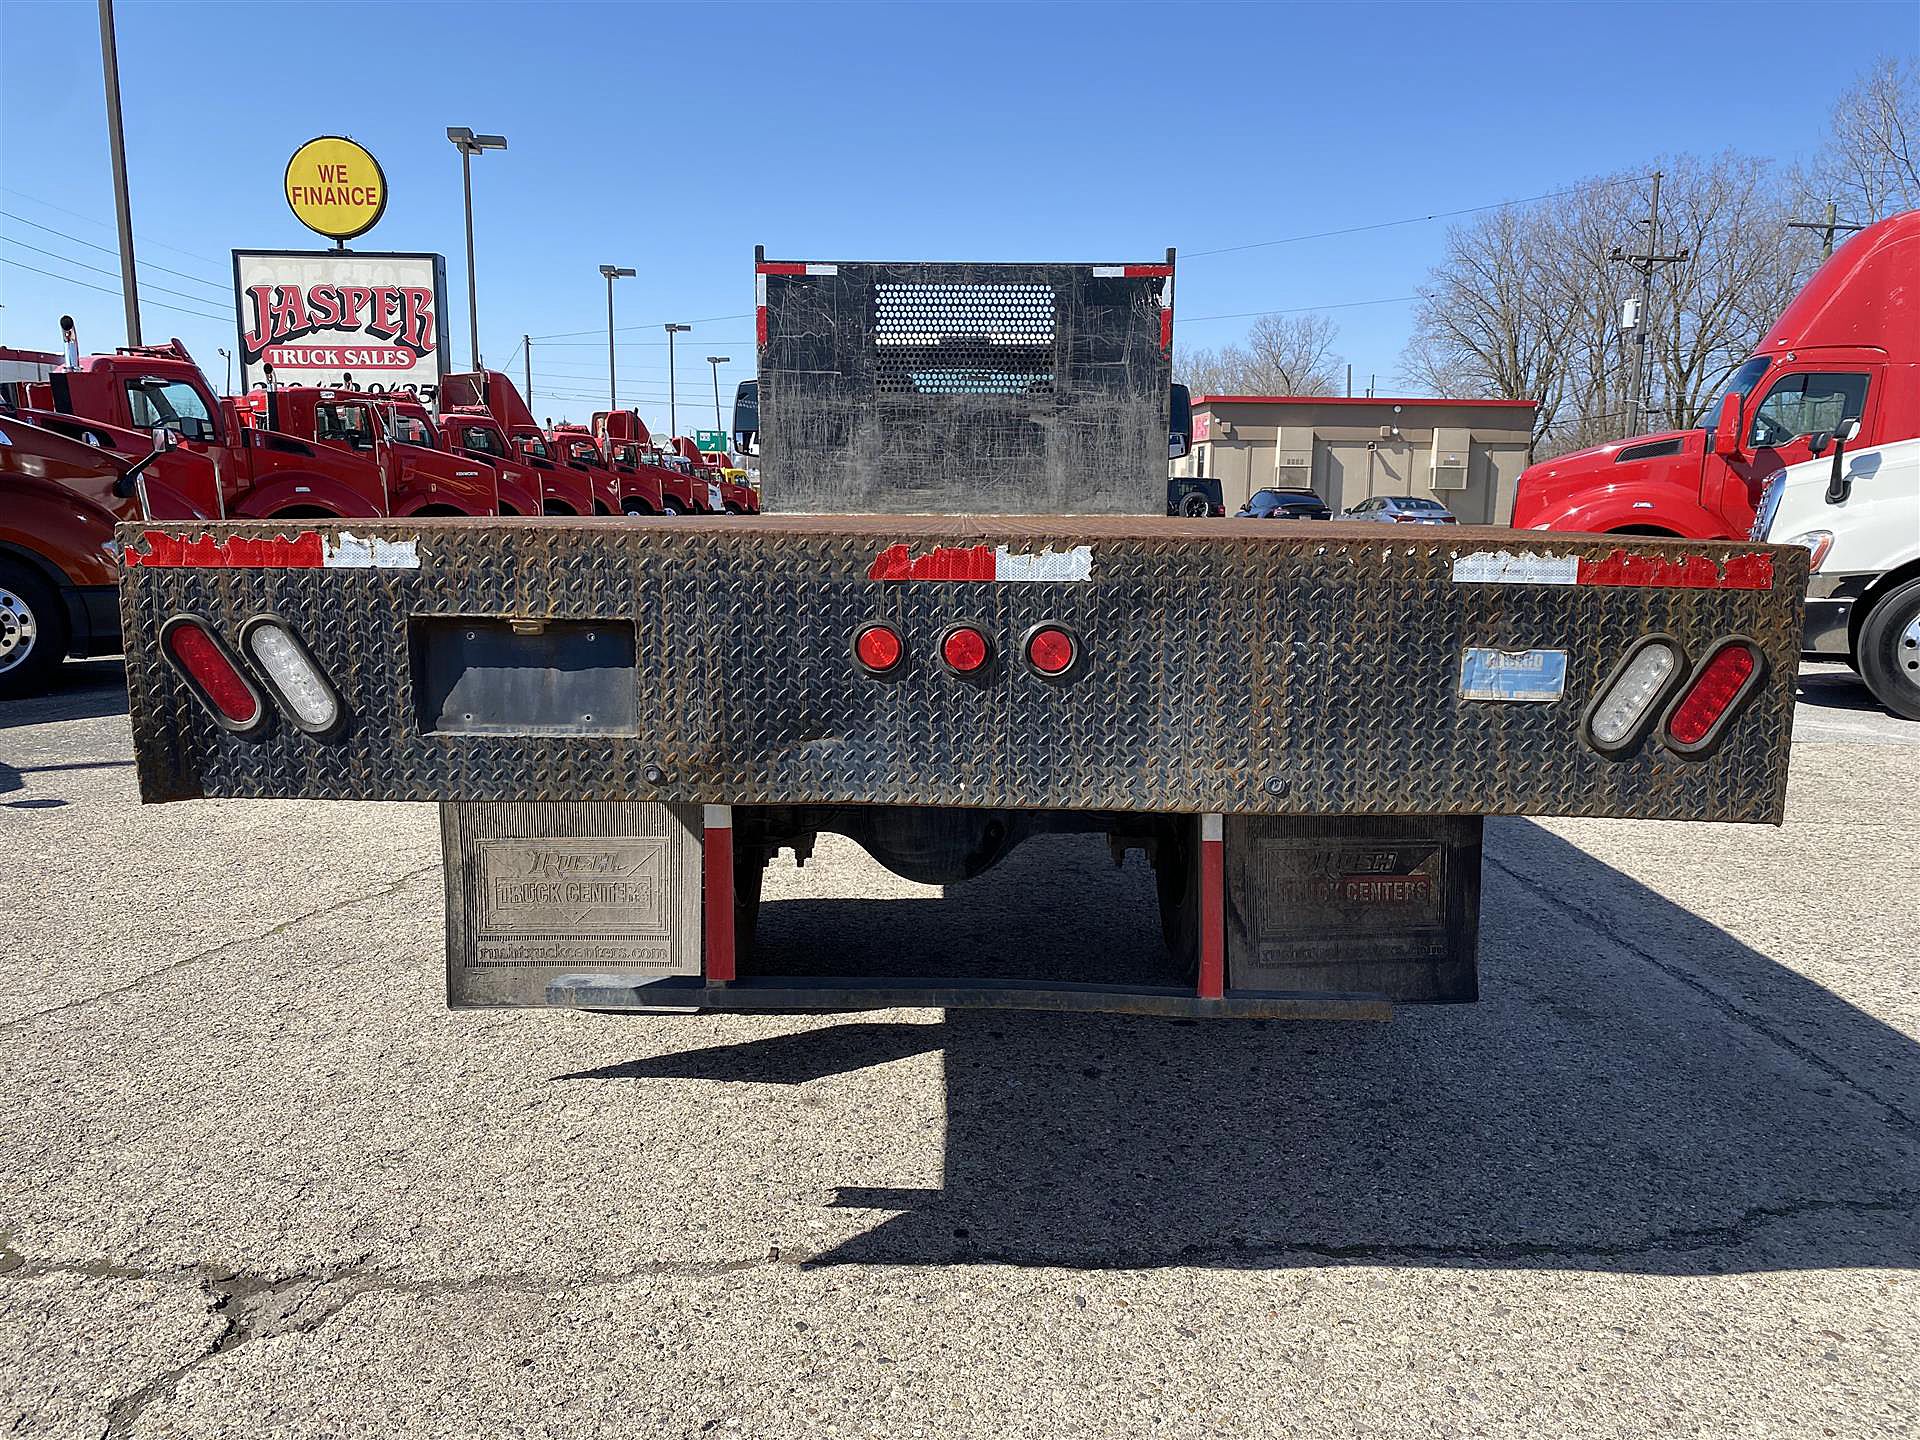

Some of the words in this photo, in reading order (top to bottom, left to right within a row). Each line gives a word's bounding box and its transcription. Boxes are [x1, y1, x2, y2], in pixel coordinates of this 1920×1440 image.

[317, 164, 348, 184] WE
[291, 186, 378, 206] FINANCE
[243, 284, 438, 362] JASPER
[268, 348, 341, 366] TRUCK
[343, 348, 411, 366] SALES
[499, 882, 562, 904] TRUCK
[565, 882, 650, 904] CENTERS
[1346, 880, 1429, 902] CENTERS
